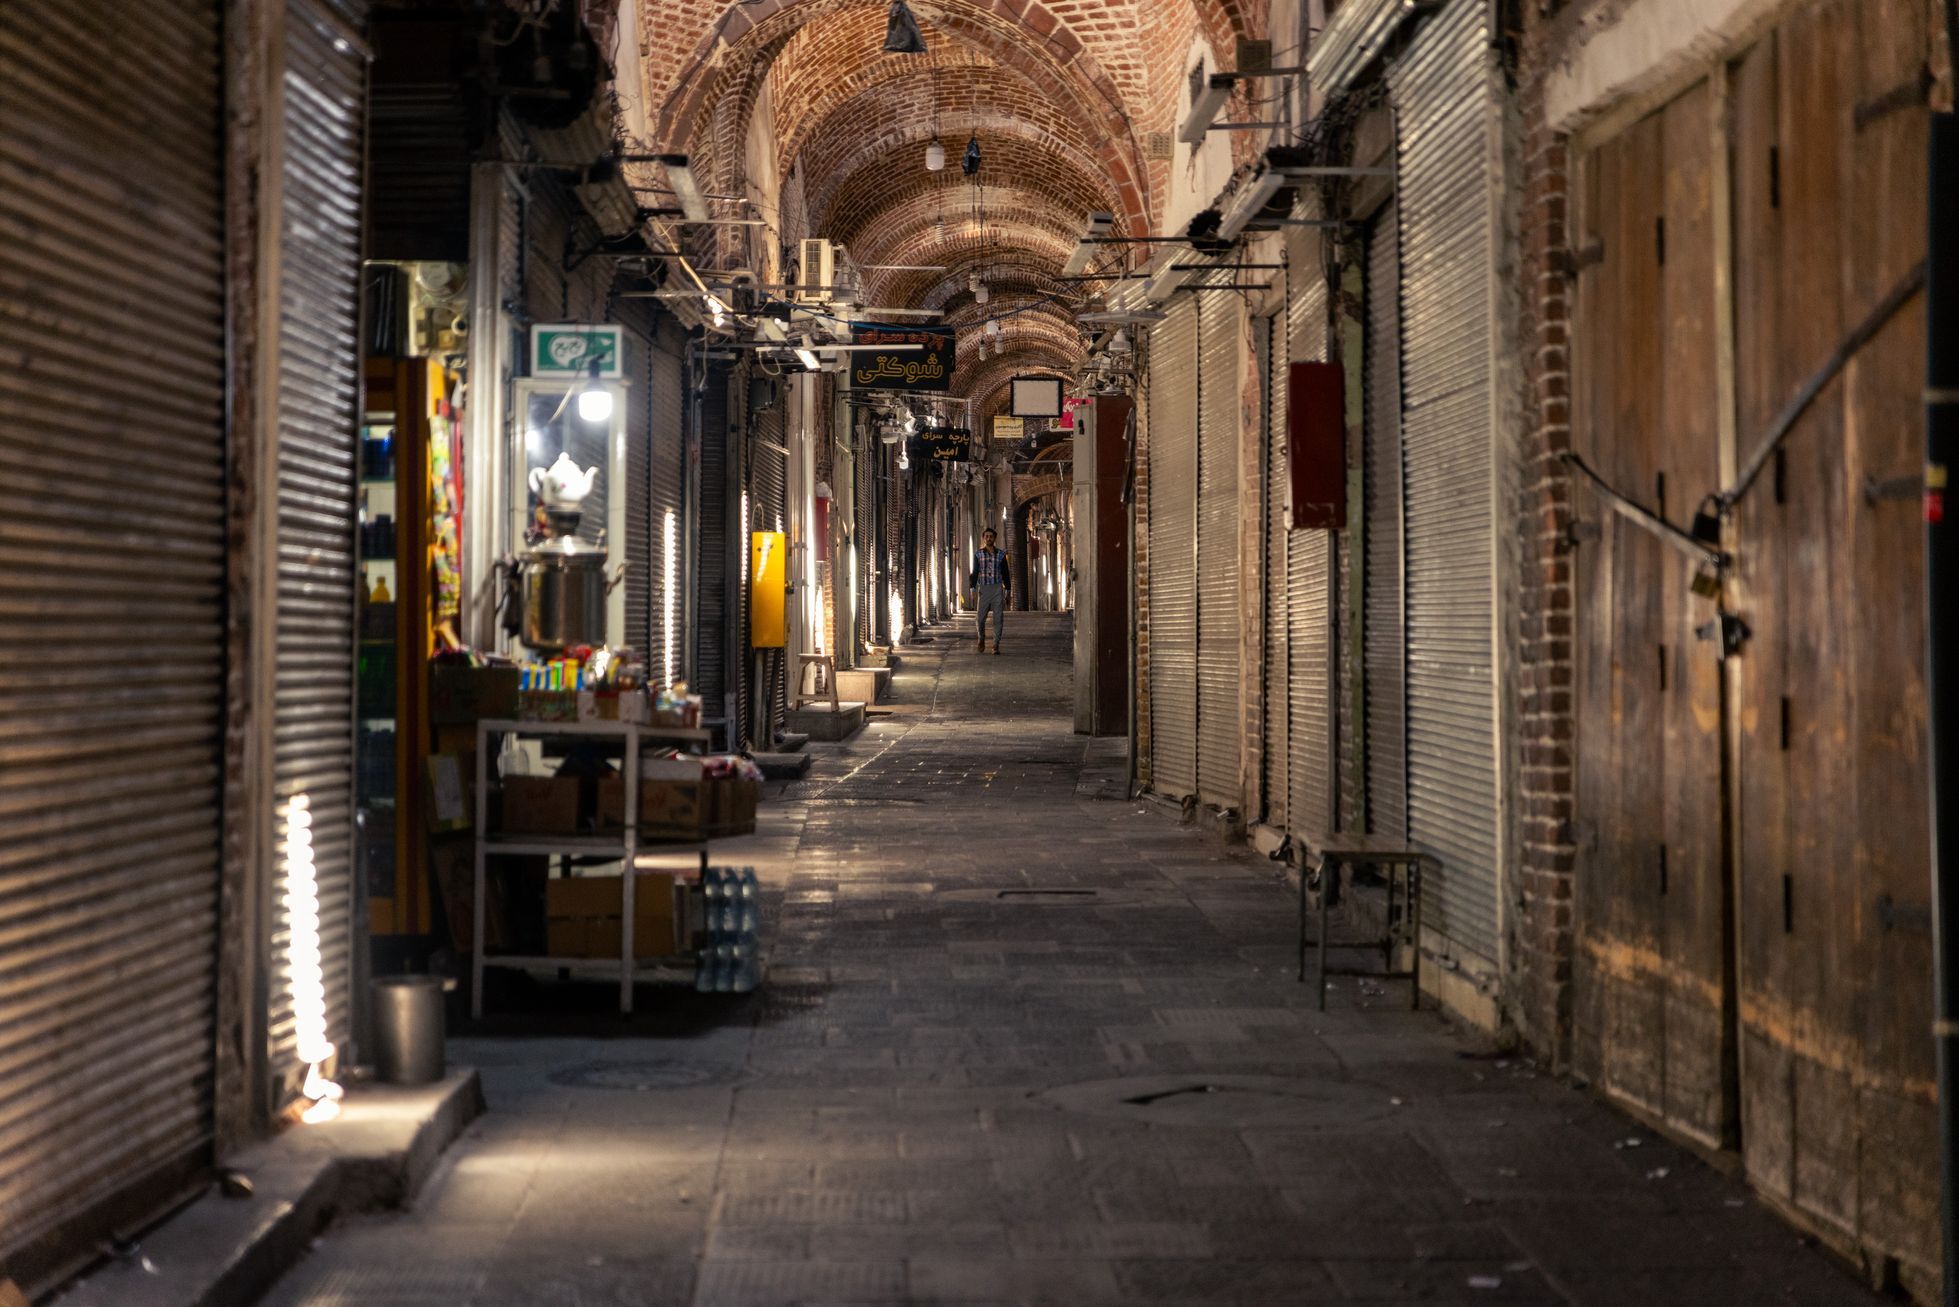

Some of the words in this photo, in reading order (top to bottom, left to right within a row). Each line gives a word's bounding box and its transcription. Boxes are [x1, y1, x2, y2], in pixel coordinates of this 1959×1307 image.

[859, 330, 905, 345] سرای
[908, 331, 945, 351] پرده
[856, 352, 944, 384] شوکتی
[921, 431, 944, 441] سرای
[948, 433, 970, 446] پارچه
[933, 446, 959, 459] امین
